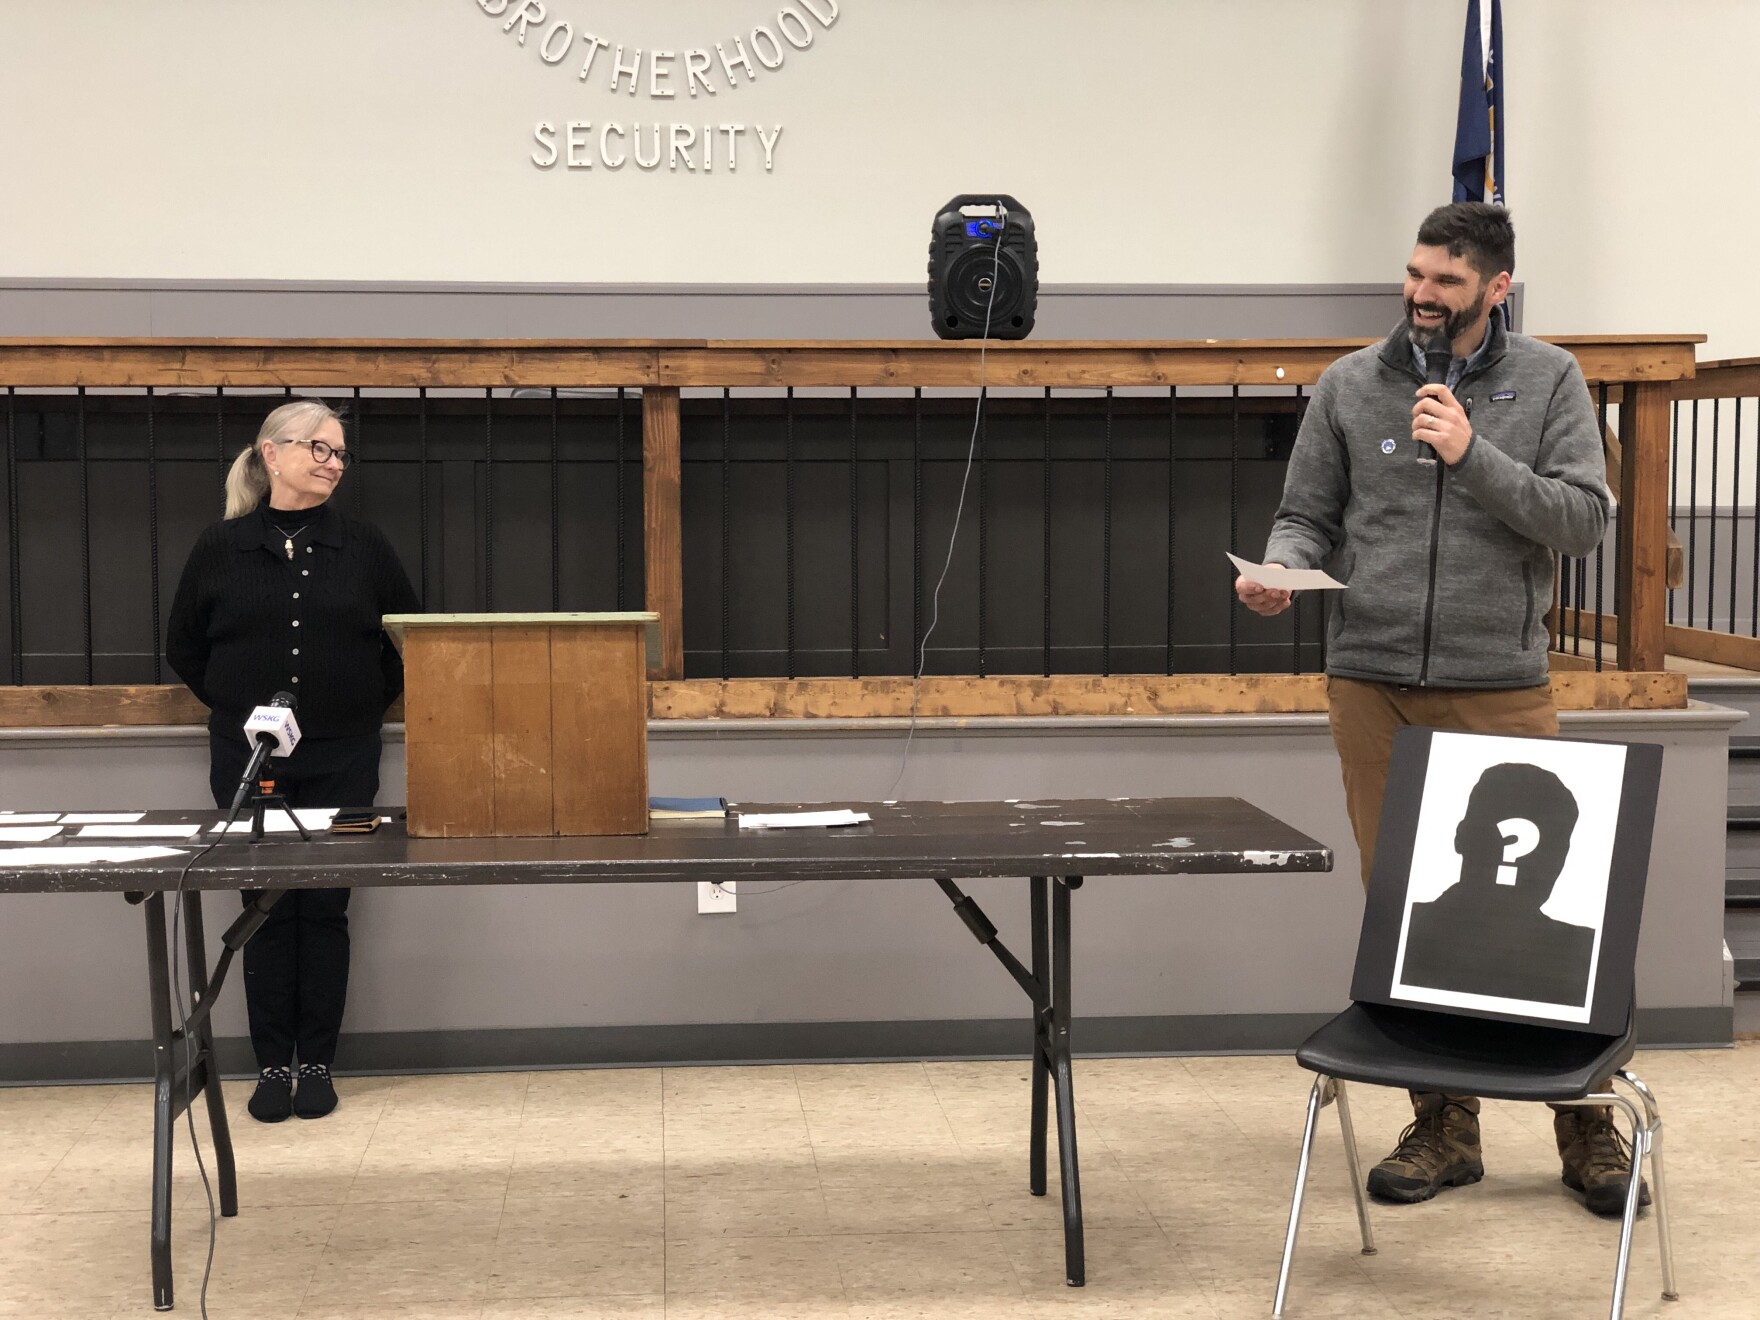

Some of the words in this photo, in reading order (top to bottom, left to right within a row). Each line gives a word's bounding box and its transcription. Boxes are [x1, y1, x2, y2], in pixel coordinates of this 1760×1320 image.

[532, 122, 783, 170] SECURITY
[253, 714, 281, 722] WSKG
[1495, 817, 1540, 886] ?
